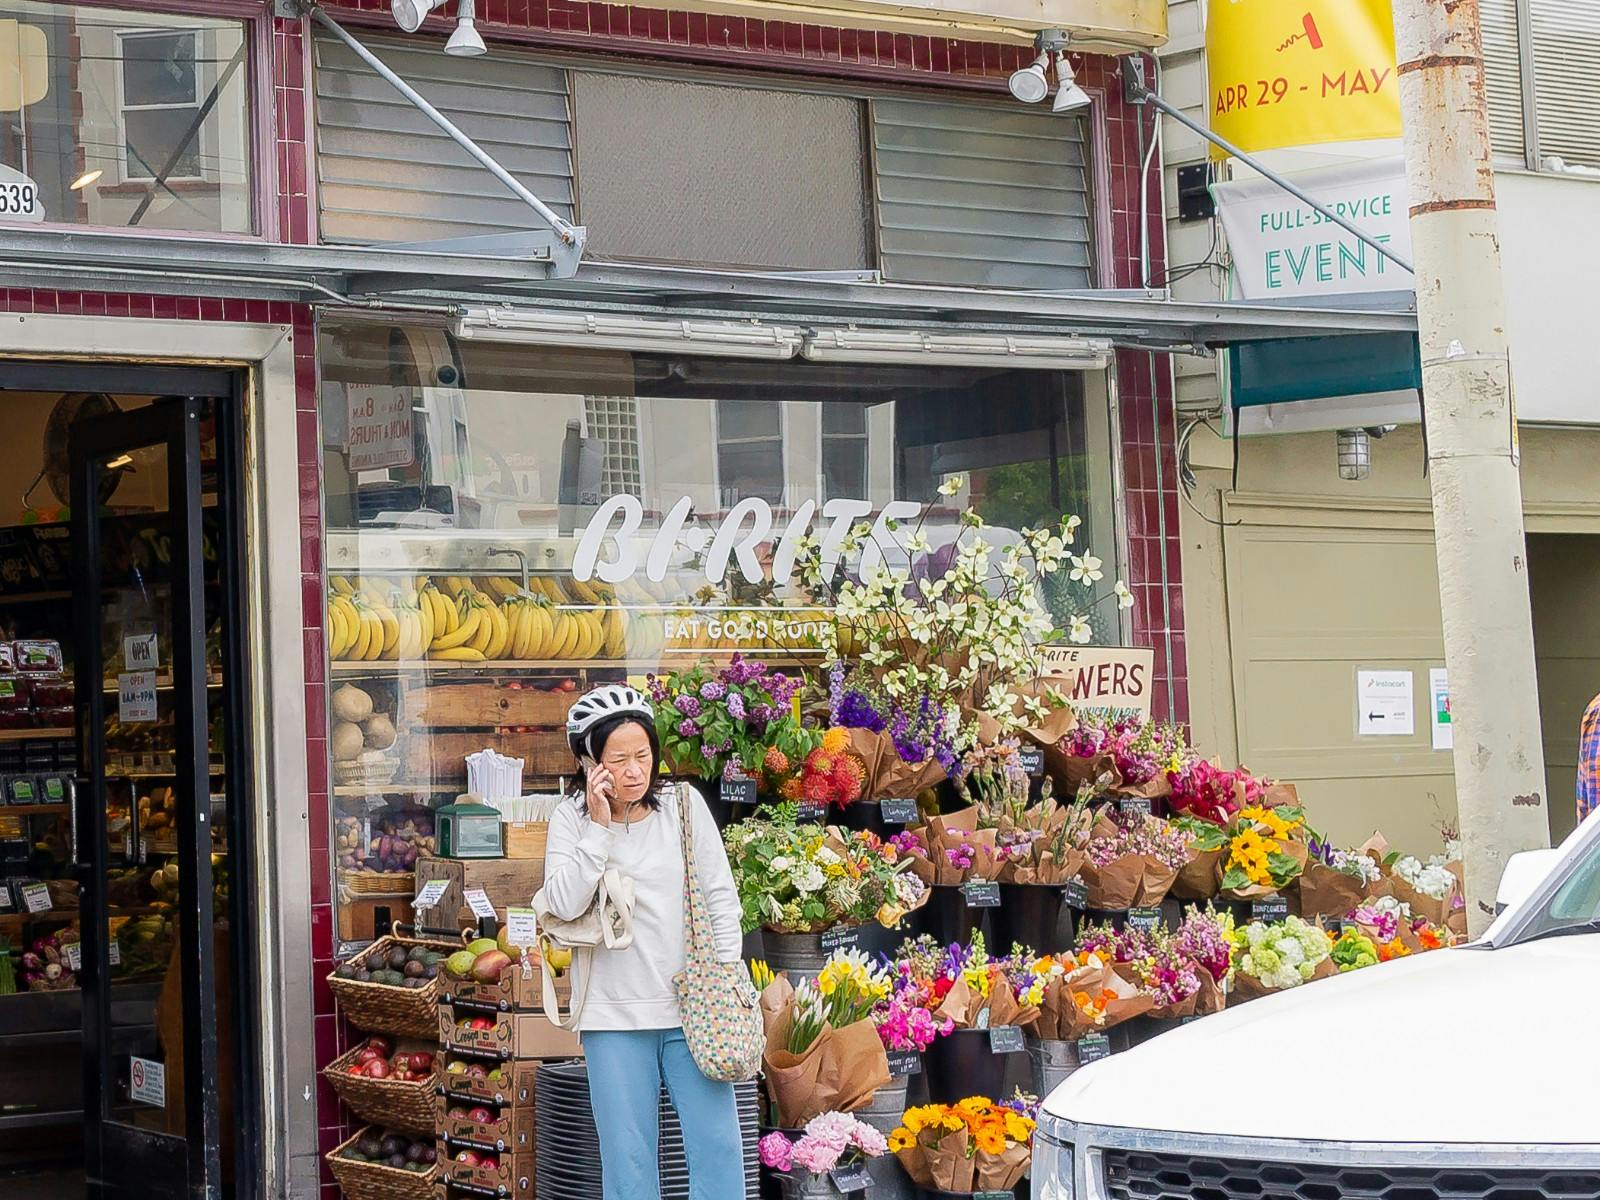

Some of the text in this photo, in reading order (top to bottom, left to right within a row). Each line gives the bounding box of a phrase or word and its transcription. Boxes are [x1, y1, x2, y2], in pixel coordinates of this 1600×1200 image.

[1216, 84, 1248, 116] APR
[1256, 78, 1288, 106] 29
[1321, 68, 1391, 98] MAY
[1260, 195, 1391, 233] FULL-SERVICE
[1265, 235, 1390, 289] EVENT
[664, 619, 701, 640] EAT
[707, 619, 768, 641] GOD
[132, 642, 151, 661] OPEN
[130, 676, 145, 686] OPEN
[721, 784, 746, 795] LILAC
[1252, 904, 1287, 913] SUNFLOWERS
